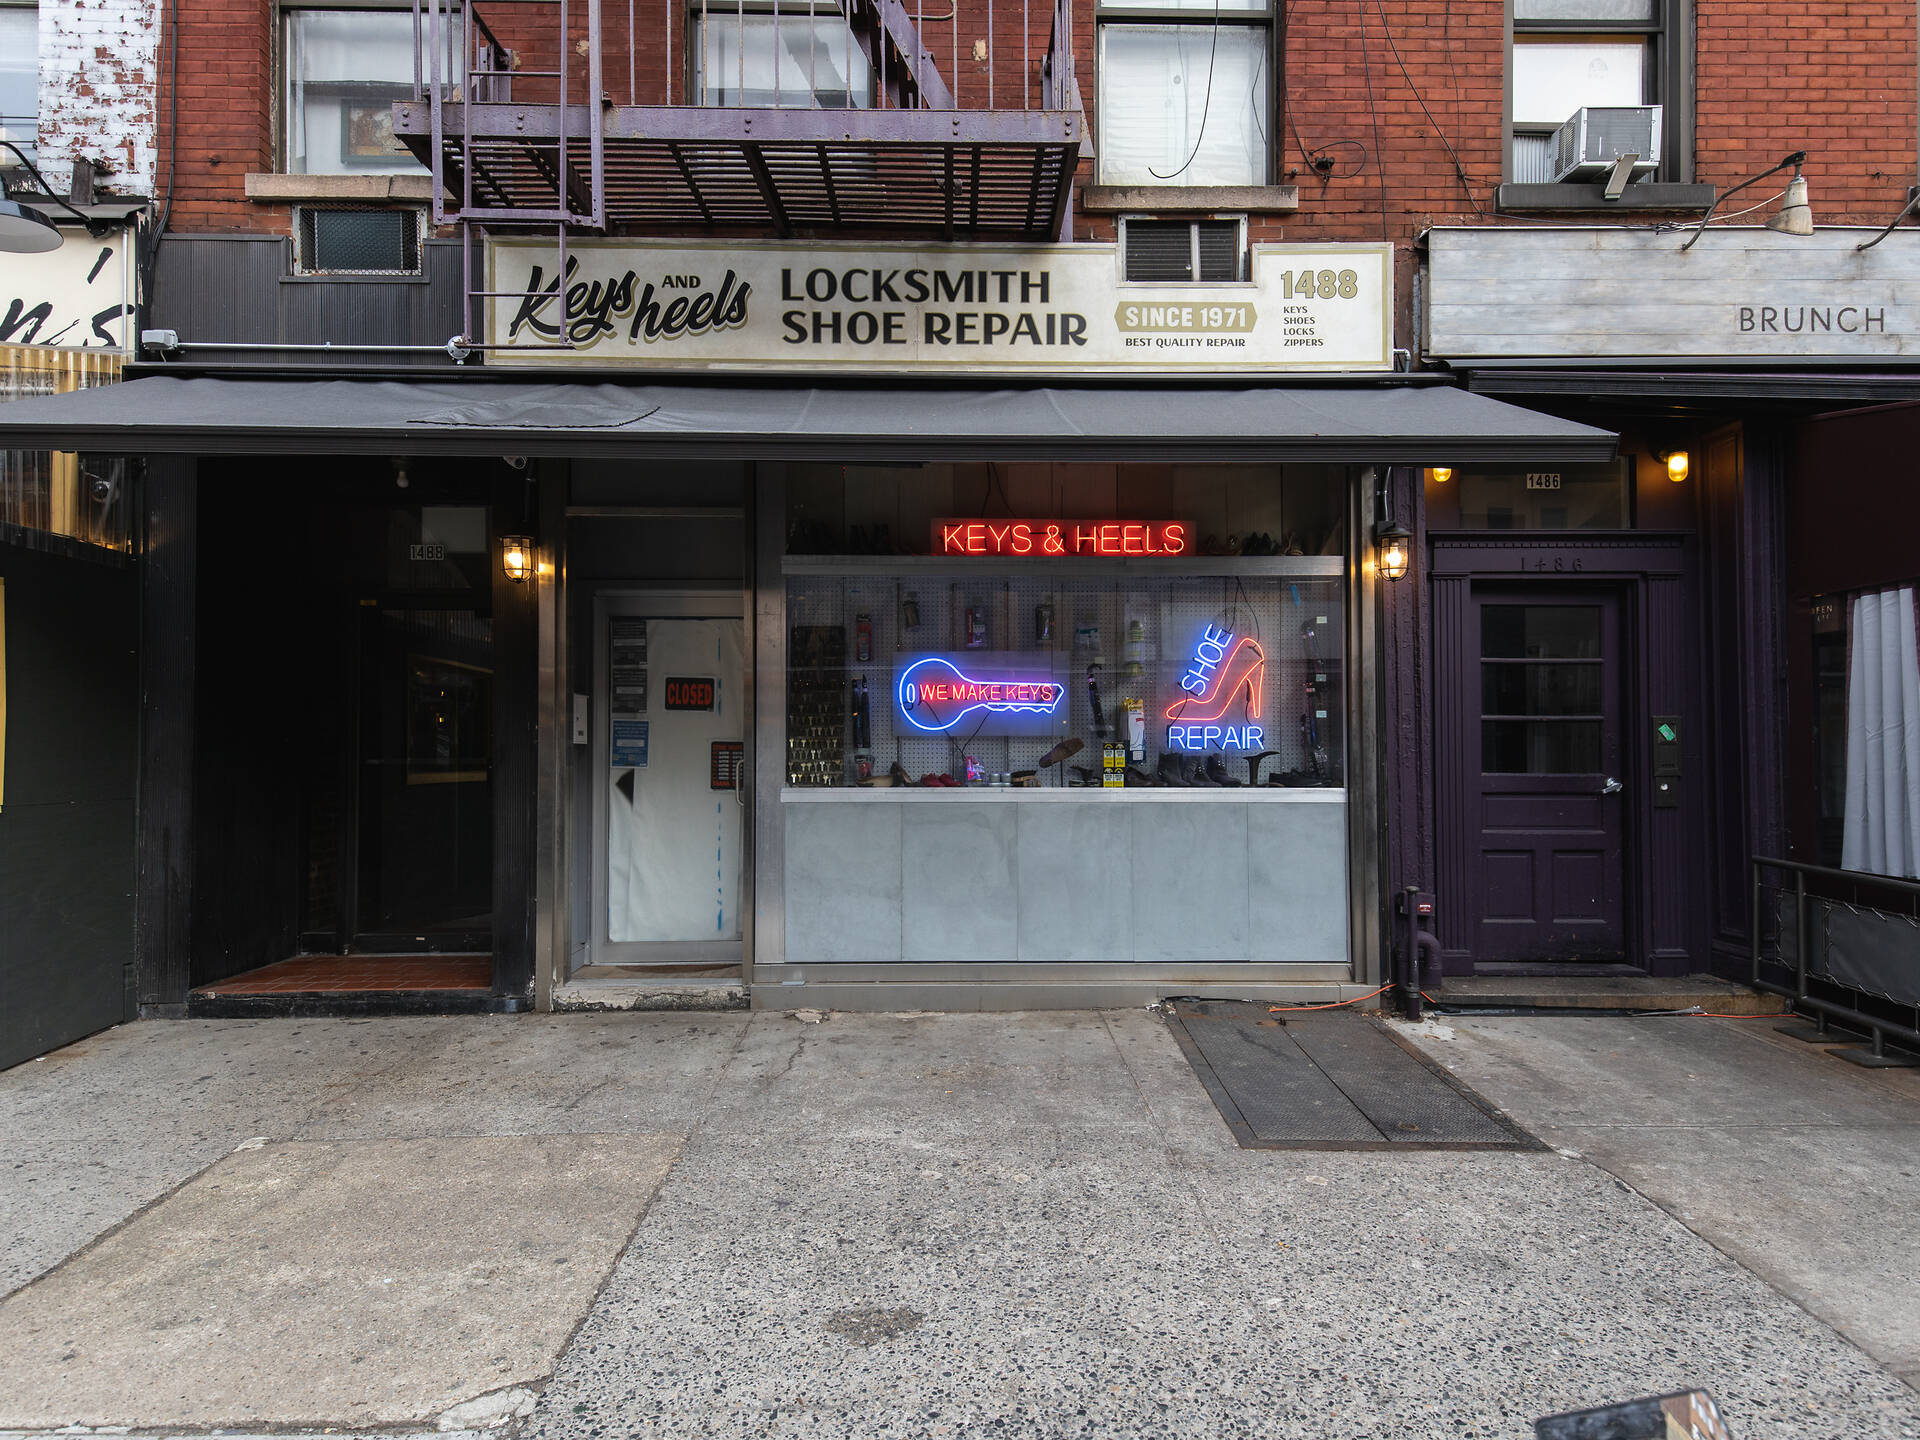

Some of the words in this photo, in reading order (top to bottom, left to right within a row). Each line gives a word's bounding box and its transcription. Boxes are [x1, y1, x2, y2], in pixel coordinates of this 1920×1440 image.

[662, 275, 701, 289] AND
[781, 268, 1050, 303] LOCKSMITH
[1280, 269, 1358, 300] 1488
[509, 254, 637, 347] Keys
[630, 269, 752, 341] heels
[1283, 305, 1308, 314] KEYS
[782, 310, 908, 345] SHOE
[923, 310, 1087, 346] REPAIR
[1126, 306, 1193, 328] SINCE
[1199, 307, 1246, 328] 1971
[1283, 316, 1316, 325] SHOES
[1740, 306, 1885, 333] BRUNCH
[1125, 337, 1151, 347] BEST
[1155, 338, 1203, 349] QUALITY
[1206, 338, 1246, 347] REPAIR
[1283, 327, 1315, 336] LOCKS
[1283, 338, 1324, 347] ZIPPERS
[1528, 474, 1560, 489] 1486
[943, 524, 1033, 553] KEYS
[1042, 524, 1066, 553] &
[1076, 524, 1185, 554] HEELS
[410, 545, 444, 560] 1488
[1180, 623, 1234, 697] SHOE
[667, 682, 713, 706] CLOSED
[919, 684, 949, 701] WE
[952, 684, 1001, 701] MAKE
[1005, 684, 1053, 702] KEYS
[1167, 725, 1265, 751] REPAIR
